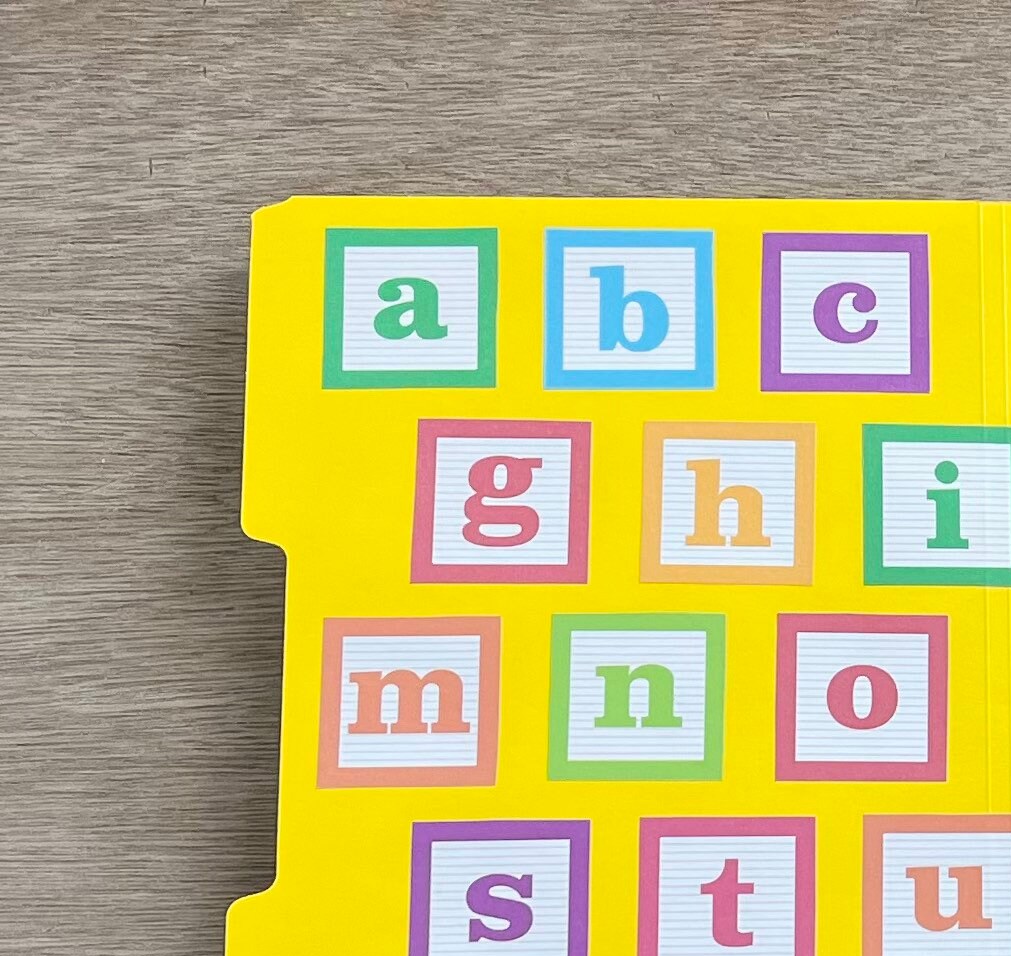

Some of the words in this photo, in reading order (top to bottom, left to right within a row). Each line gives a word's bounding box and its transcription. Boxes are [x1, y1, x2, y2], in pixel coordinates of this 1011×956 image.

[374, 277, 448, 339] a
[590, 265, 669, 352] b
[814, 283, 877, 343] c
[463, 456, 542, 547] g
[687, 459, 771, 546] h
[927, 461, 969, 548] i
[349, 670, 470, 734] m
[595, 664, 682, 727] n
[827, 665, 898, 730] o
[466, 874, 532, 941] s
[701, 859, 754, 947] t
[907, 866, 992, 931] u
